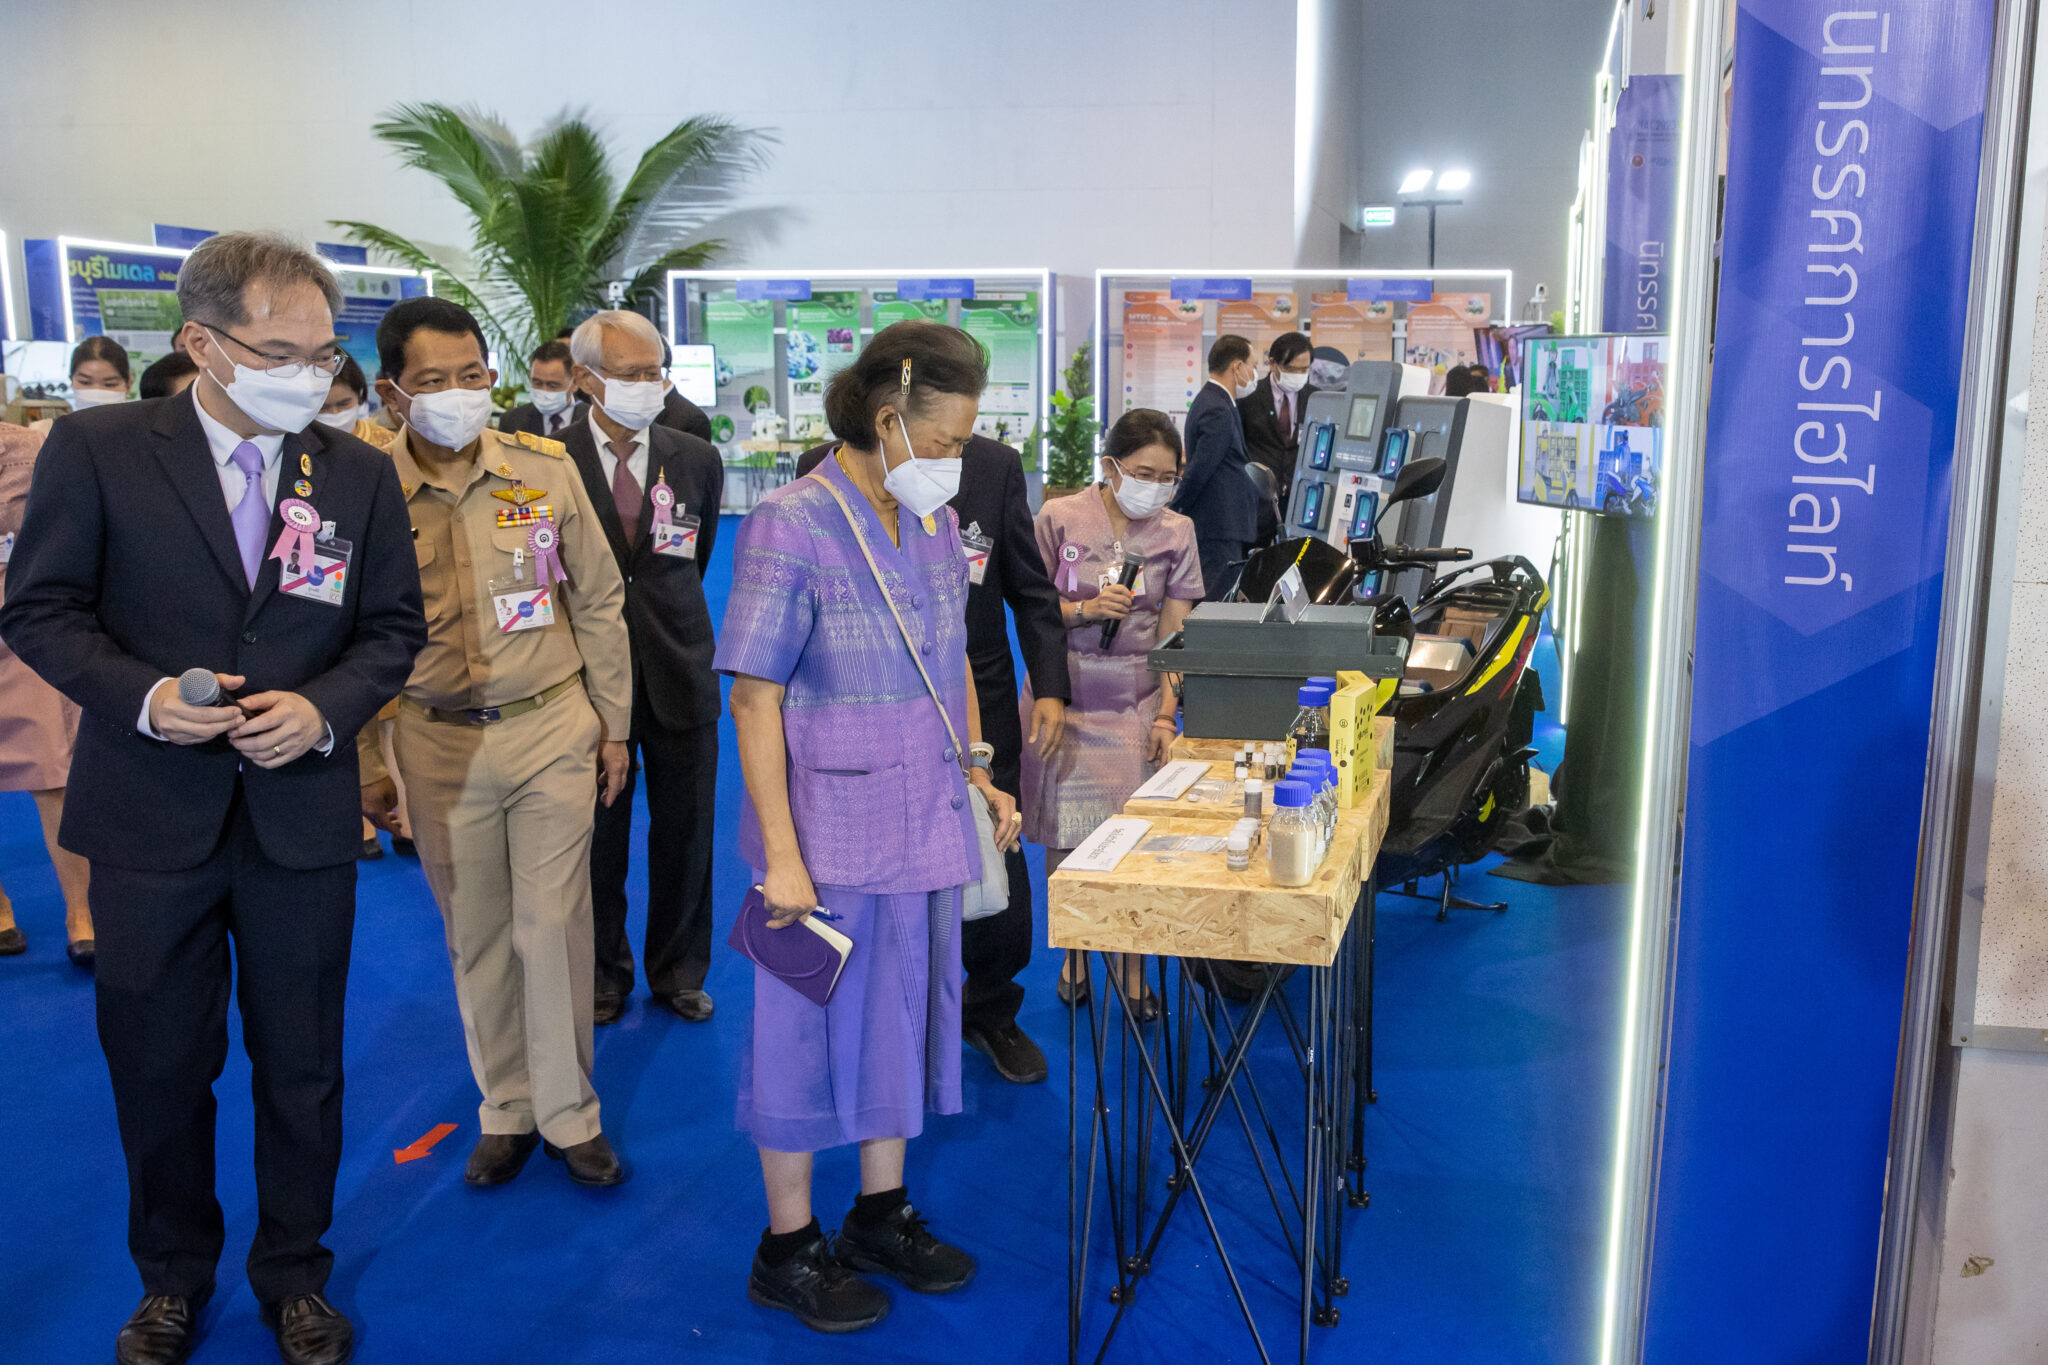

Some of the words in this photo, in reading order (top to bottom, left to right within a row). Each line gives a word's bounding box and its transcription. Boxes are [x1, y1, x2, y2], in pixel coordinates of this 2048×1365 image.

[1784, 11, 1891, 591] นิทรรศการไฮไลท์
